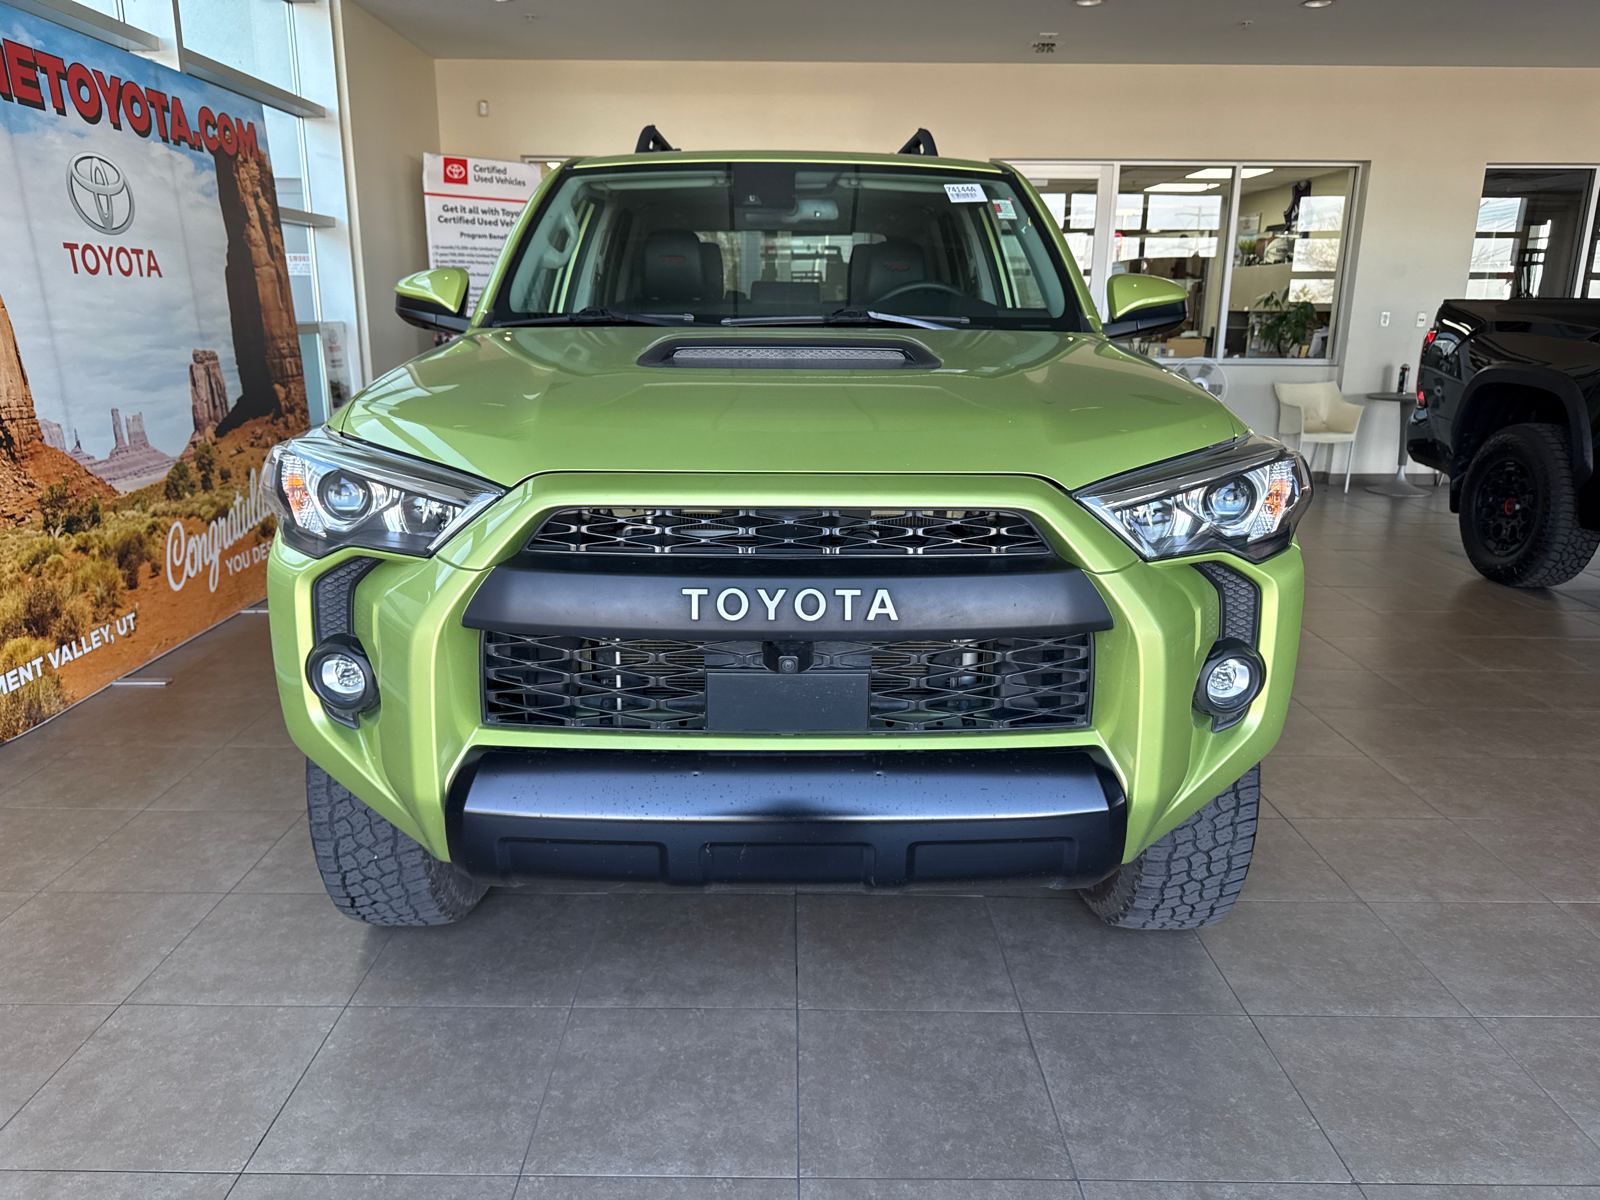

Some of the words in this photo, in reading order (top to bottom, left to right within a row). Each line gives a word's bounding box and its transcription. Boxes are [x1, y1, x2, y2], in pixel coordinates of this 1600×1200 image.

[473, 164, 507, 175] Certified
[473, 175, 495, 184] Used
[495, 177, 527, 187] Vehicles
[442, 204, 459, 213] Get
[460, 205, 467, 214] it
[468, 206, 480, 215] all
[481, 207, 500, 216] with
[438, 215, 476, 226] Certified
[477, 217, 499, 227] Used
[460, 231, 488, 241] Program
[63, 242, 163, 278] TOYOTA
[225, 549, 251, 576] YOU
[681, 587, 899, 621] TOYOTA
[47, 626, 115, 670] VALLEY,
[116, 612, 136, 636] UT
